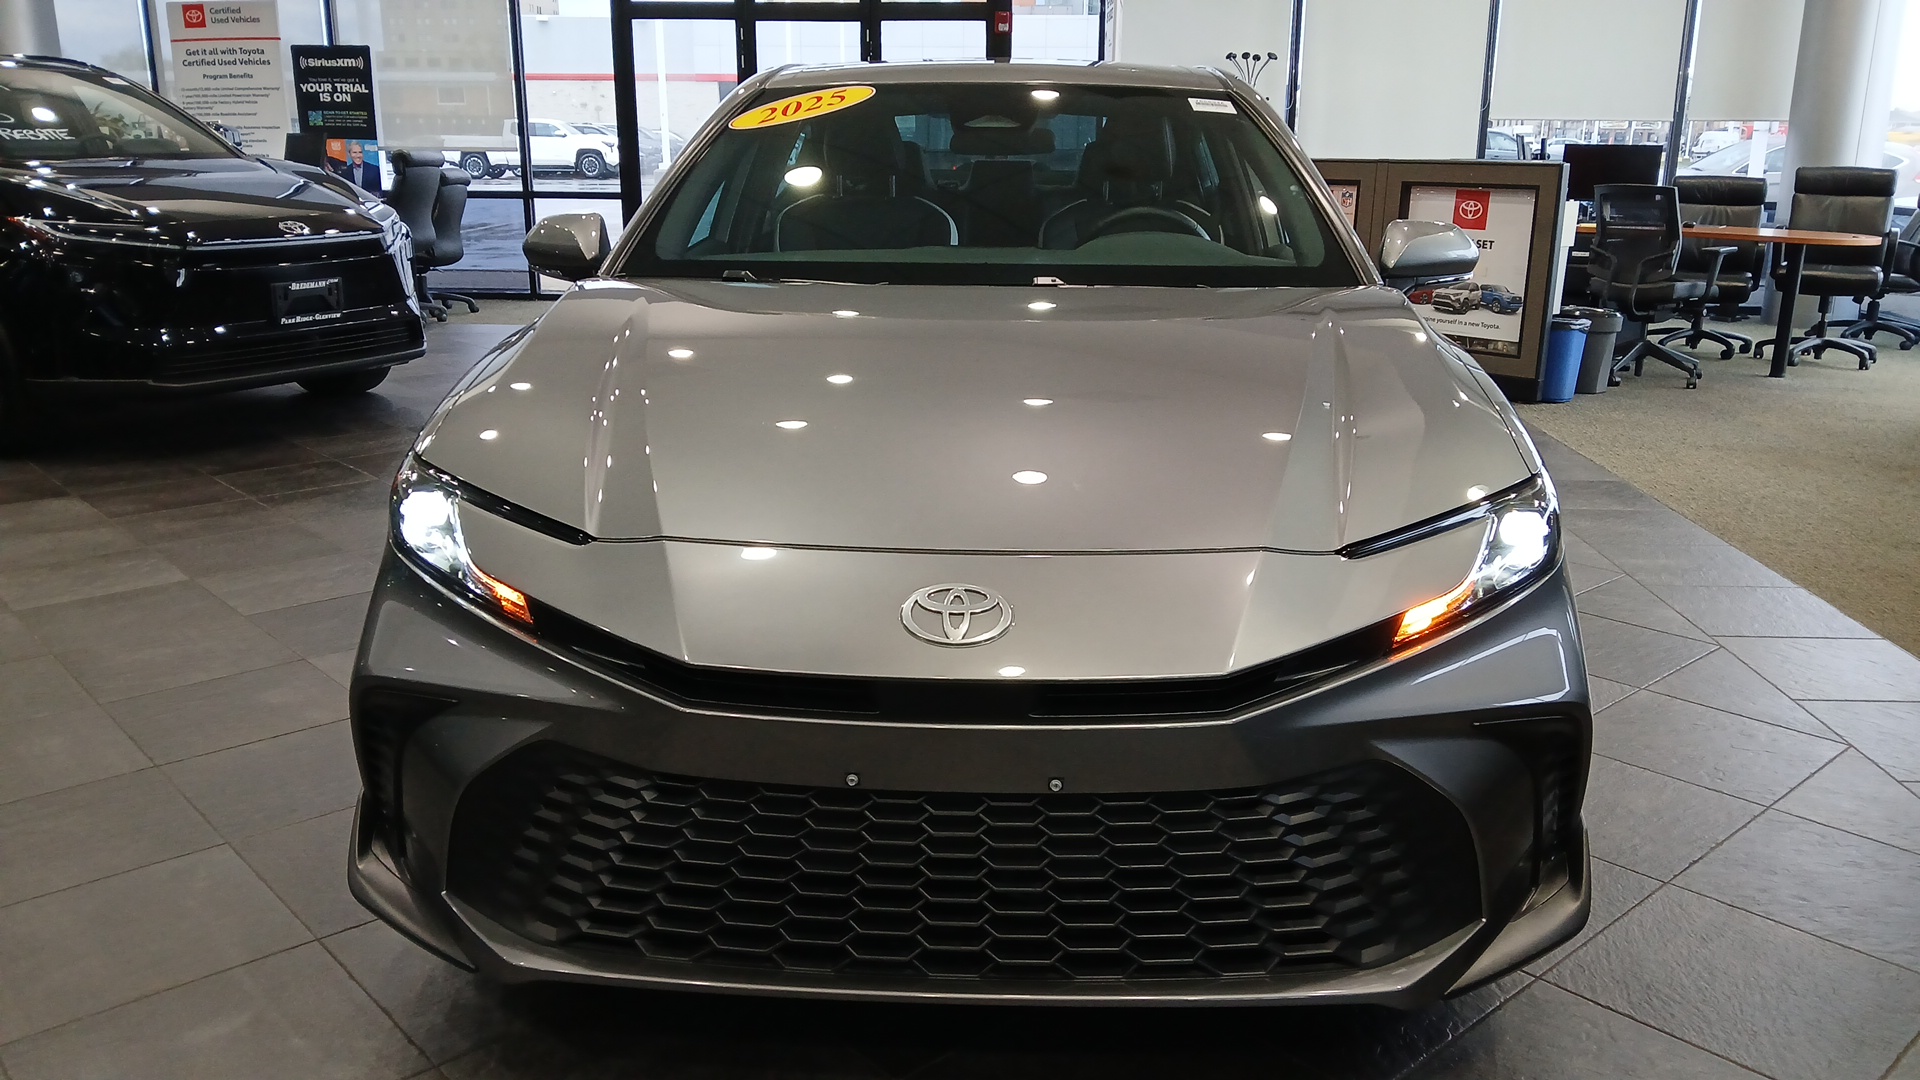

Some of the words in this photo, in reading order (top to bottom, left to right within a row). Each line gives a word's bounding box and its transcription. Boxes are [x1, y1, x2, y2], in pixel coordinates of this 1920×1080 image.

[209, 7, 241, 15] Certified
[211, 16, 229, 24] Used
[185, 48, 200, 56] Get
[201, 48, 207, 56] it
[238, 47, 265, 57] Toyota
[182, 59, 216, 67] Certified
[238, 58, 271, 66] Vehicles
[300, 83, 332, 93] YOUR
[335, 83, 369, 93] TRIAL
[319, 93, 331, 102] IS
[333, 93, 351, 102] ON
[757, 88, 848, 125] 2025
[1476, 239, 1495, 250] SET
[1436, 316, 1457, 326] yourself
